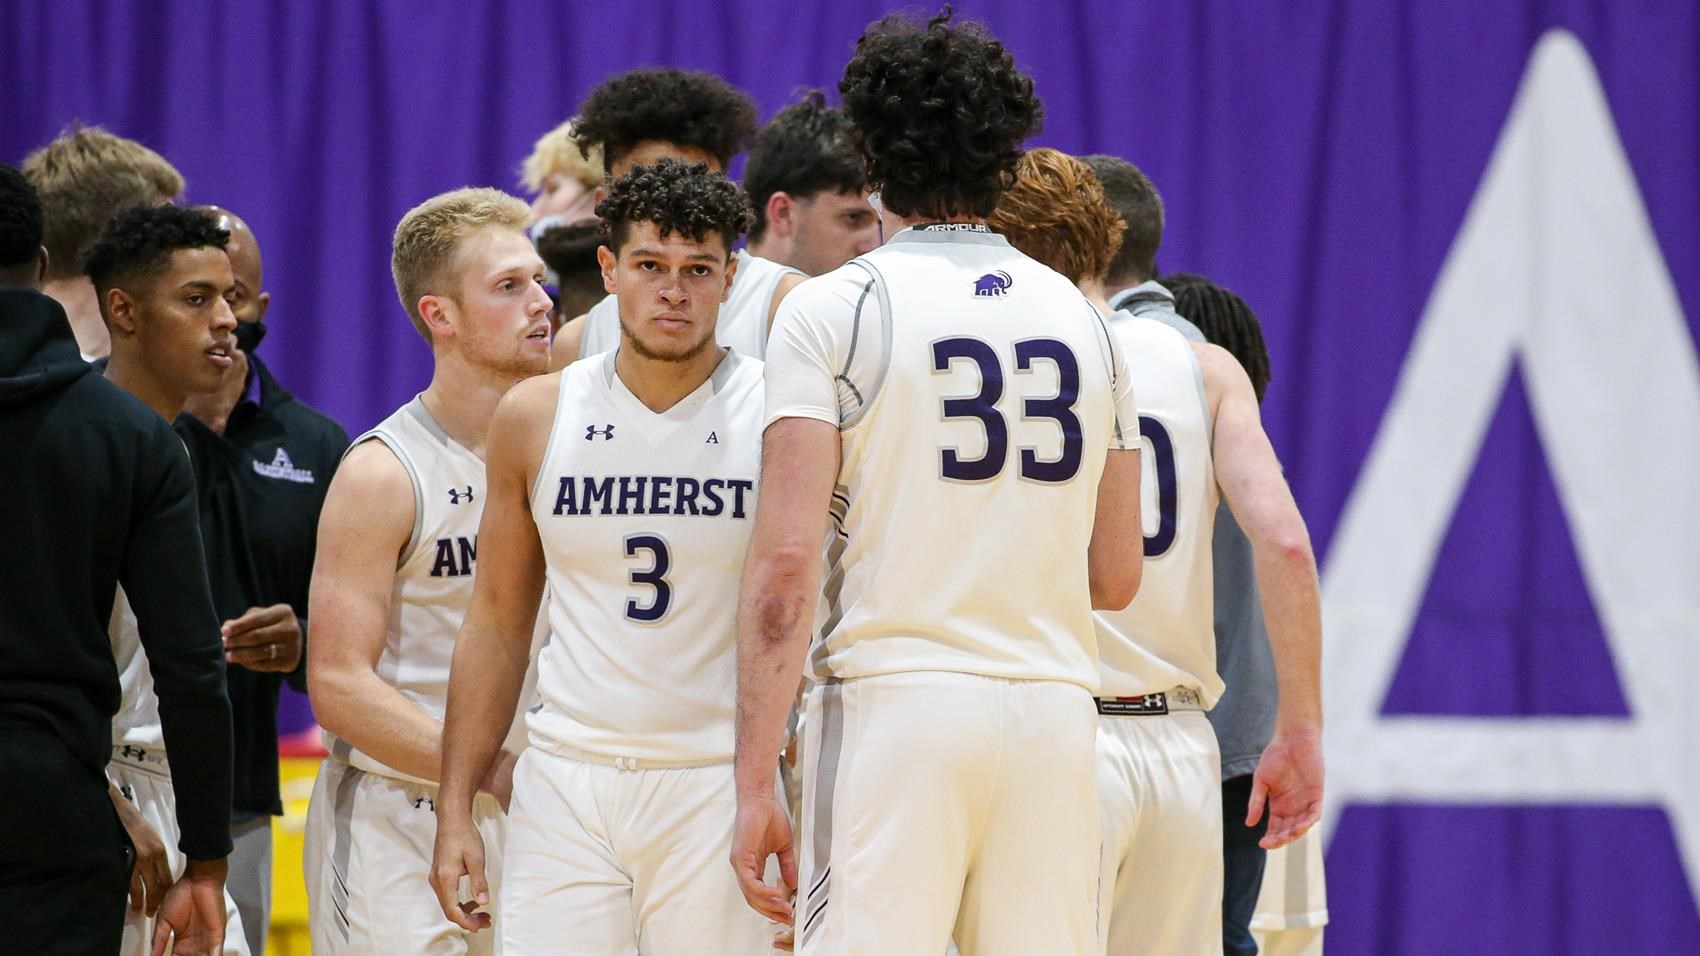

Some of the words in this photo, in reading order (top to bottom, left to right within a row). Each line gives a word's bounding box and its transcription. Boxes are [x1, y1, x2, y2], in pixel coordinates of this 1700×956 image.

[923, 223, 987, 233] ARMOUR
[705, 431, 719, 444] A
[930, 336, 1086, 485] 33
[552, 475, 753, 519] AMHERST
[1320, 28, 1700, 912] A
[623, 532, 675, 625] 3
